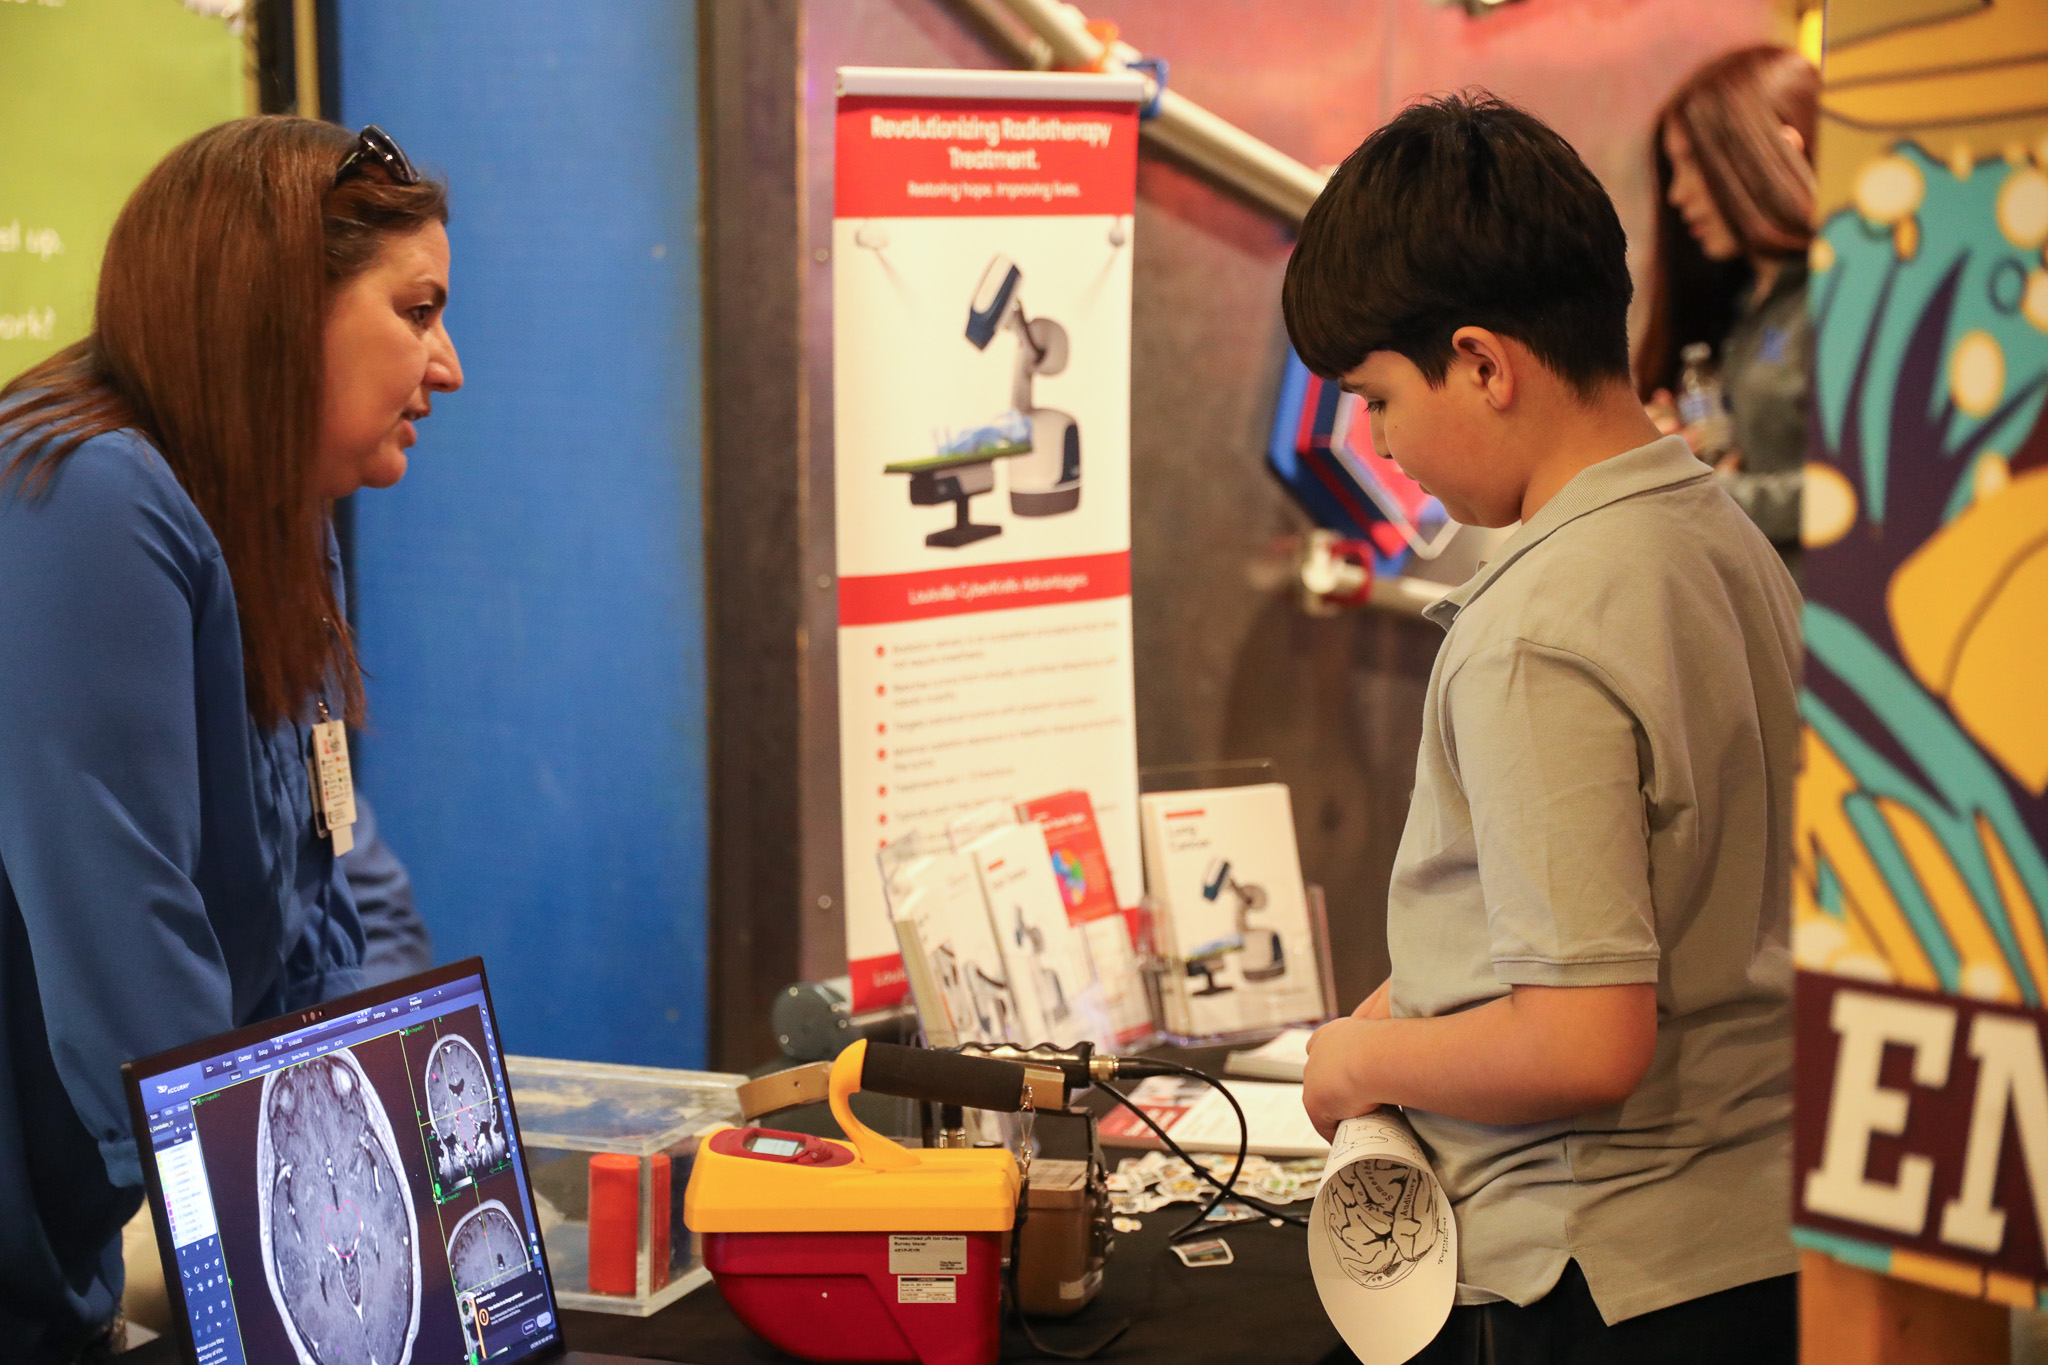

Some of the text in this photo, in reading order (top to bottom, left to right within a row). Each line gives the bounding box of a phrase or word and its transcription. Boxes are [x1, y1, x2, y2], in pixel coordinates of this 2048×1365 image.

[870, 114, 1112, 148] Revolutionizing Radiotherapy
[948, 147, 1041, 170] Treatment.
[167, 1082, 190, 1094] ACCURAY
[1400, 1178, 1417, 1216] Auditory
